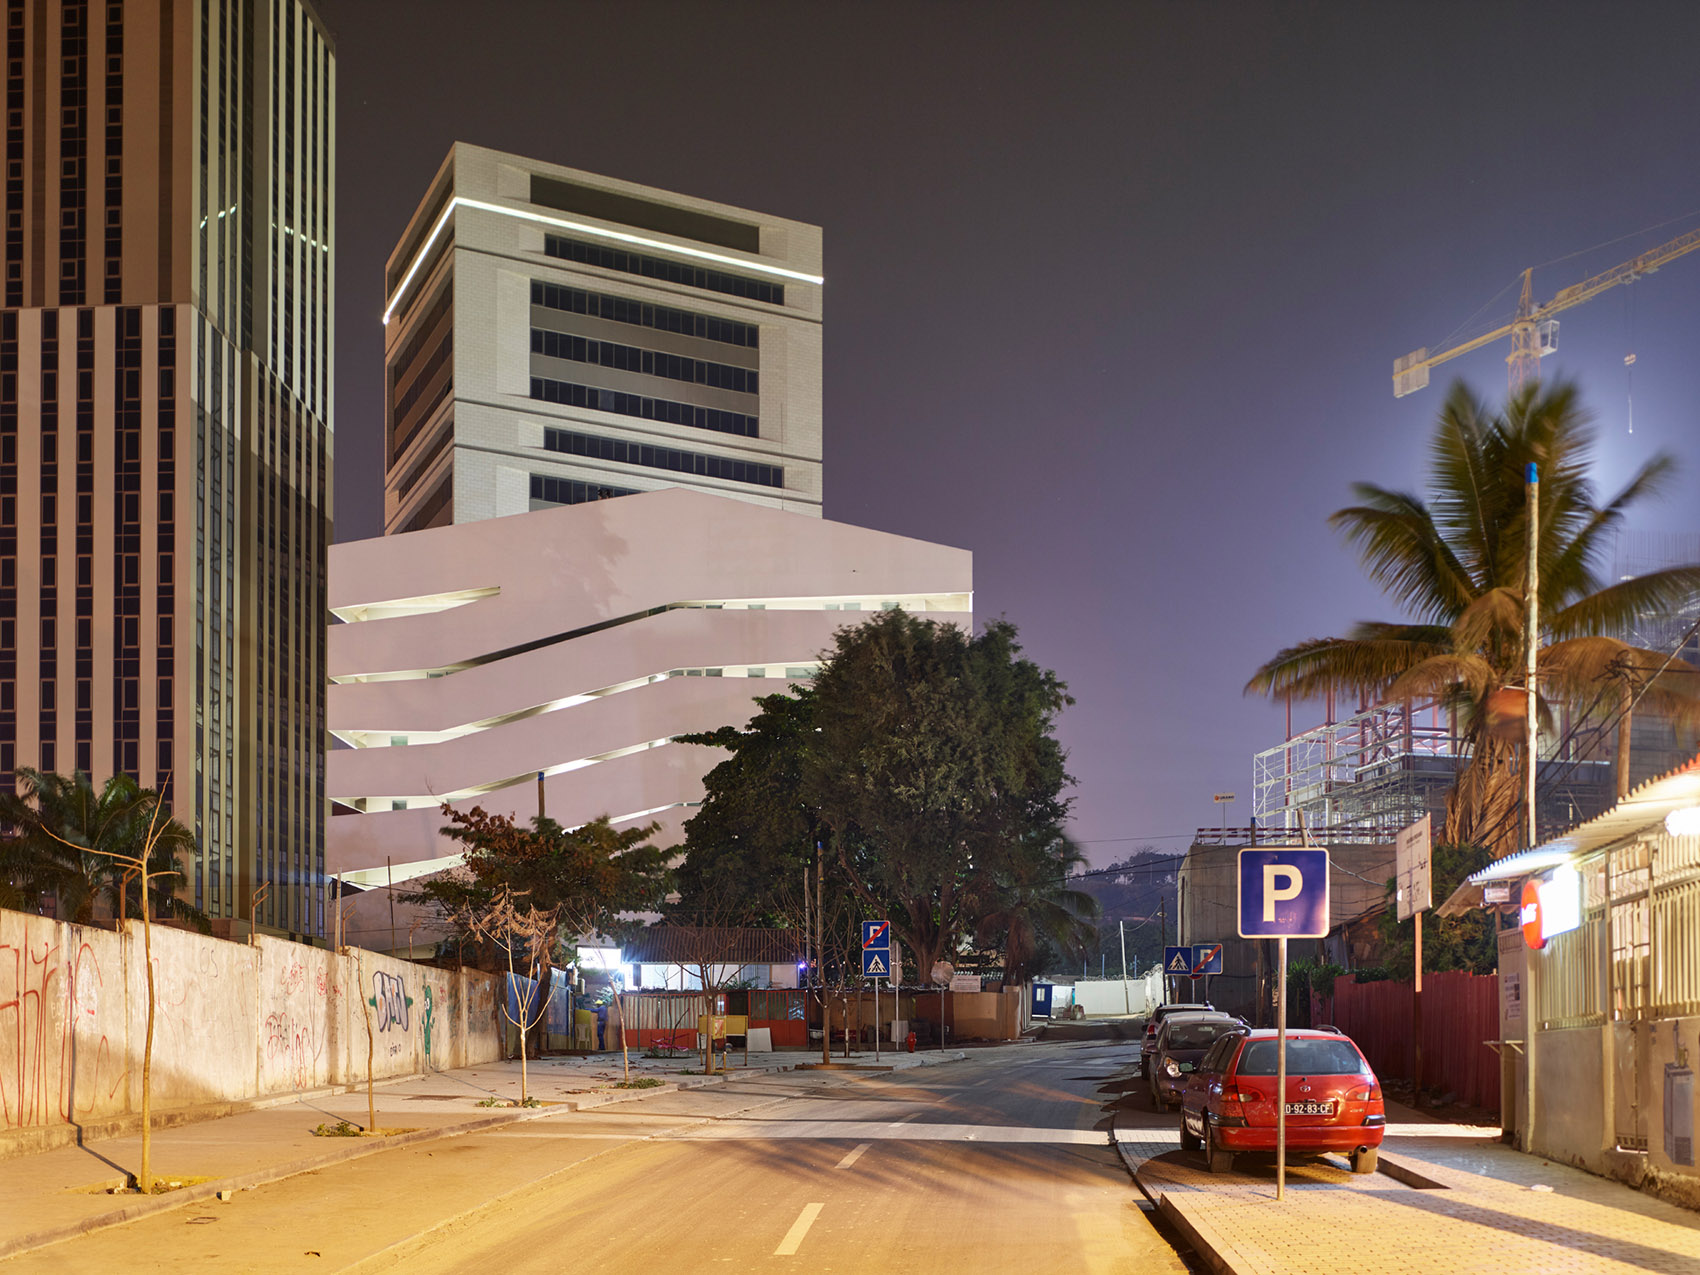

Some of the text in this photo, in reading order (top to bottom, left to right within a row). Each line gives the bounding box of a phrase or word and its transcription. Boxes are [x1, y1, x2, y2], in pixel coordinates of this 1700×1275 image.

[1263, 864, 1303, 922] P
[869, 925, 883, 944] P
[1200, 949, 1215, 969] P
[1285, 1104, 1331, 1114] D-92-83-CF
